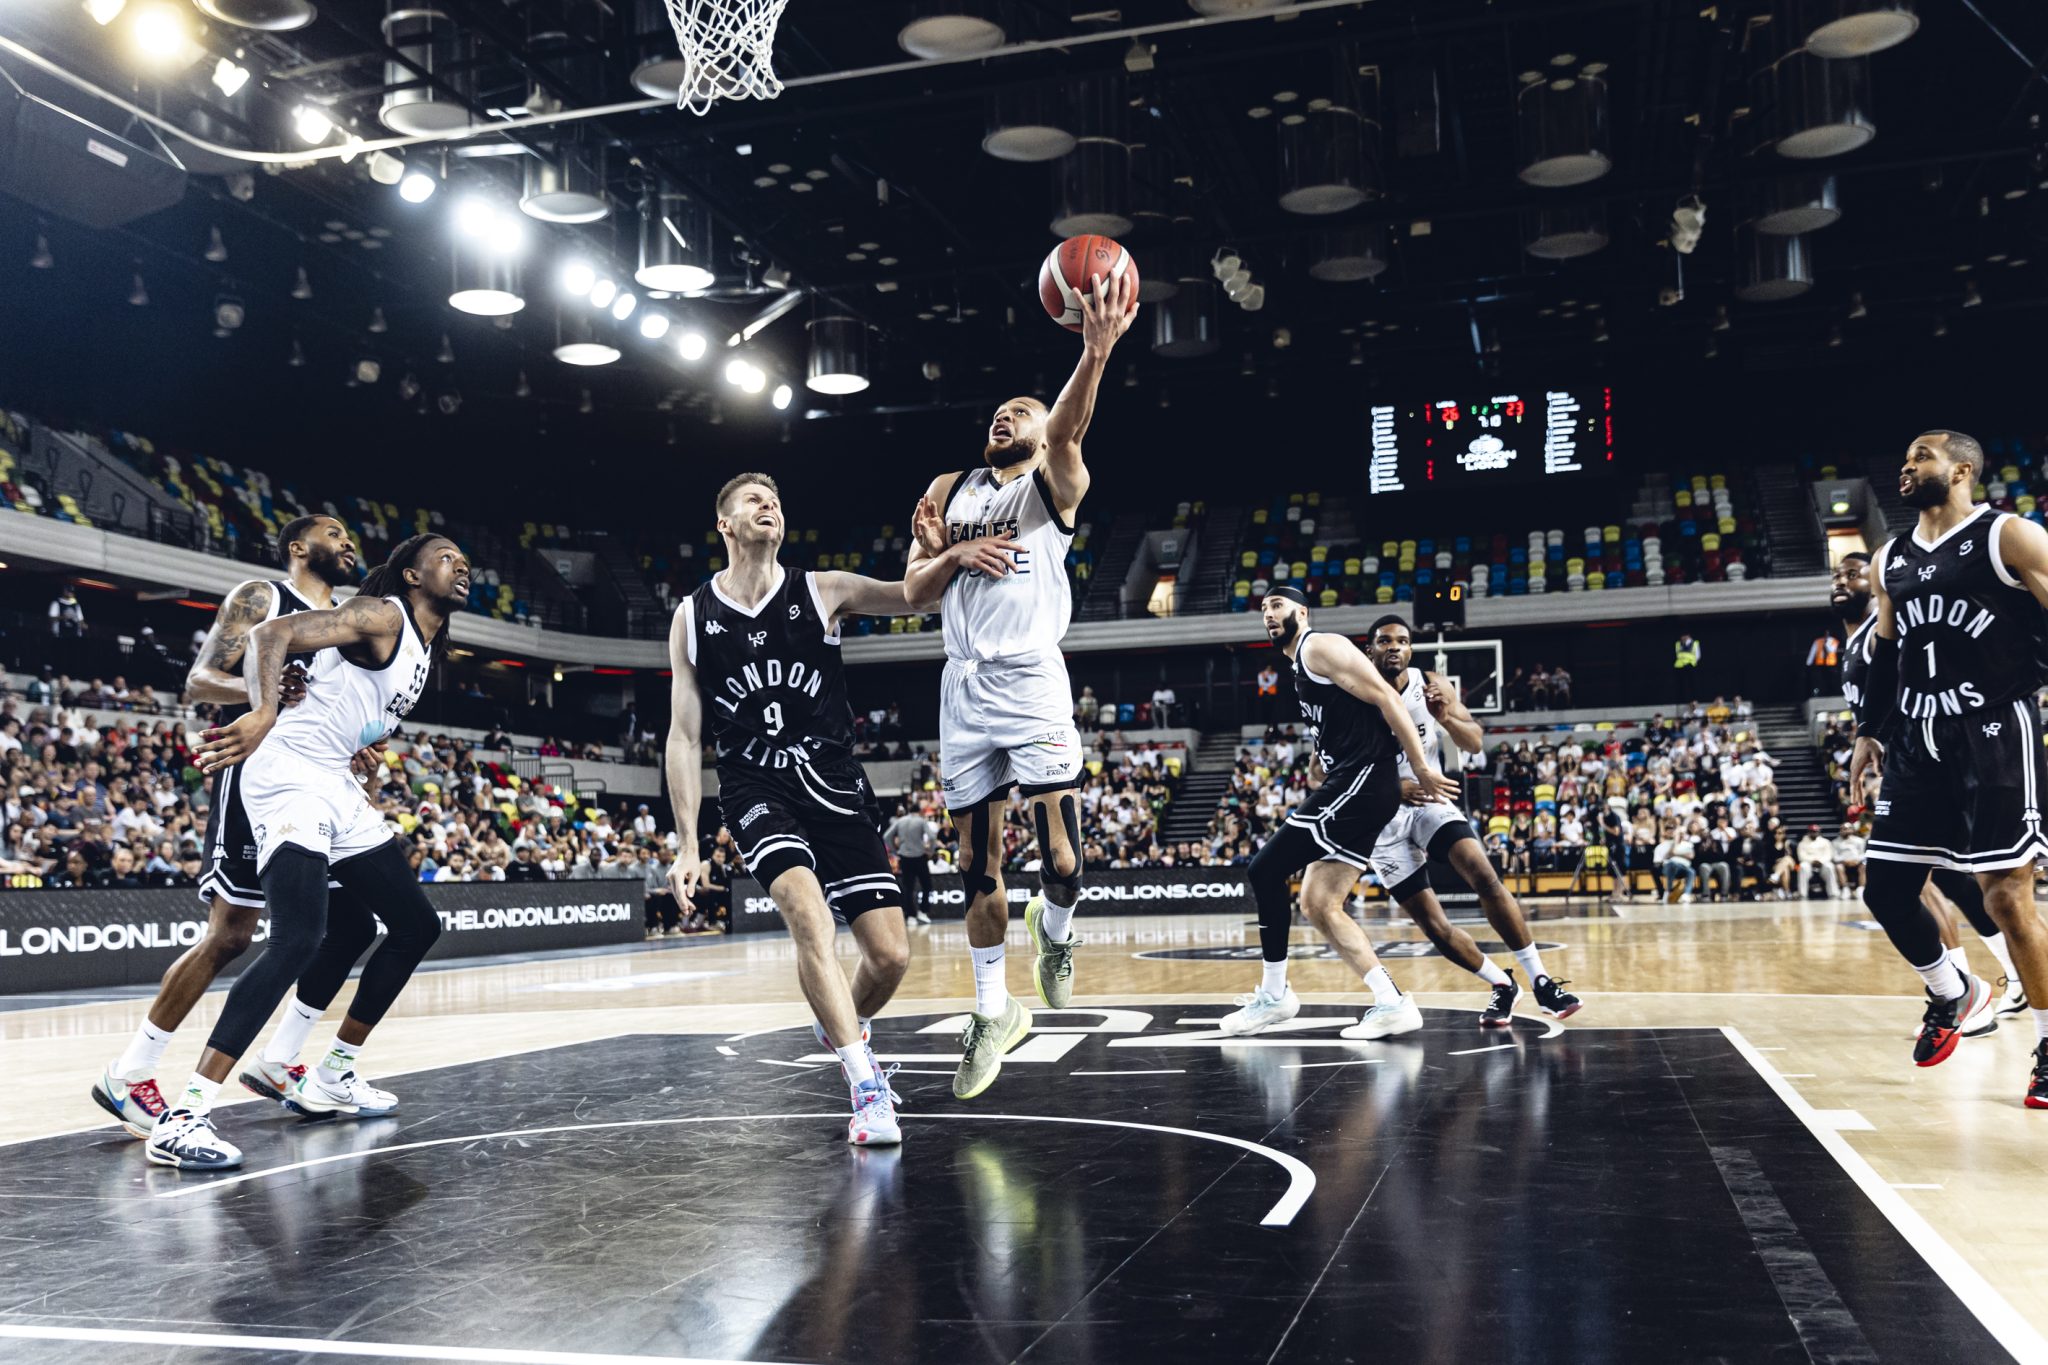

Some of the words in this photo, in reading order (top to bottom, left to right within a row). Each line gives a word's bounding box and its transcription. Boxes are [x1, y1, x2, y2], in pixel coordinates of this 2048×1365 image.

[1456, 449, 1517, 464] LONDON
[1923, 641, 1937, 679] 1
[715, 659, 823, 713] LONDON
[1901, 681, 1986, 719] LIONS
[763, 701, 785, 736] 9
